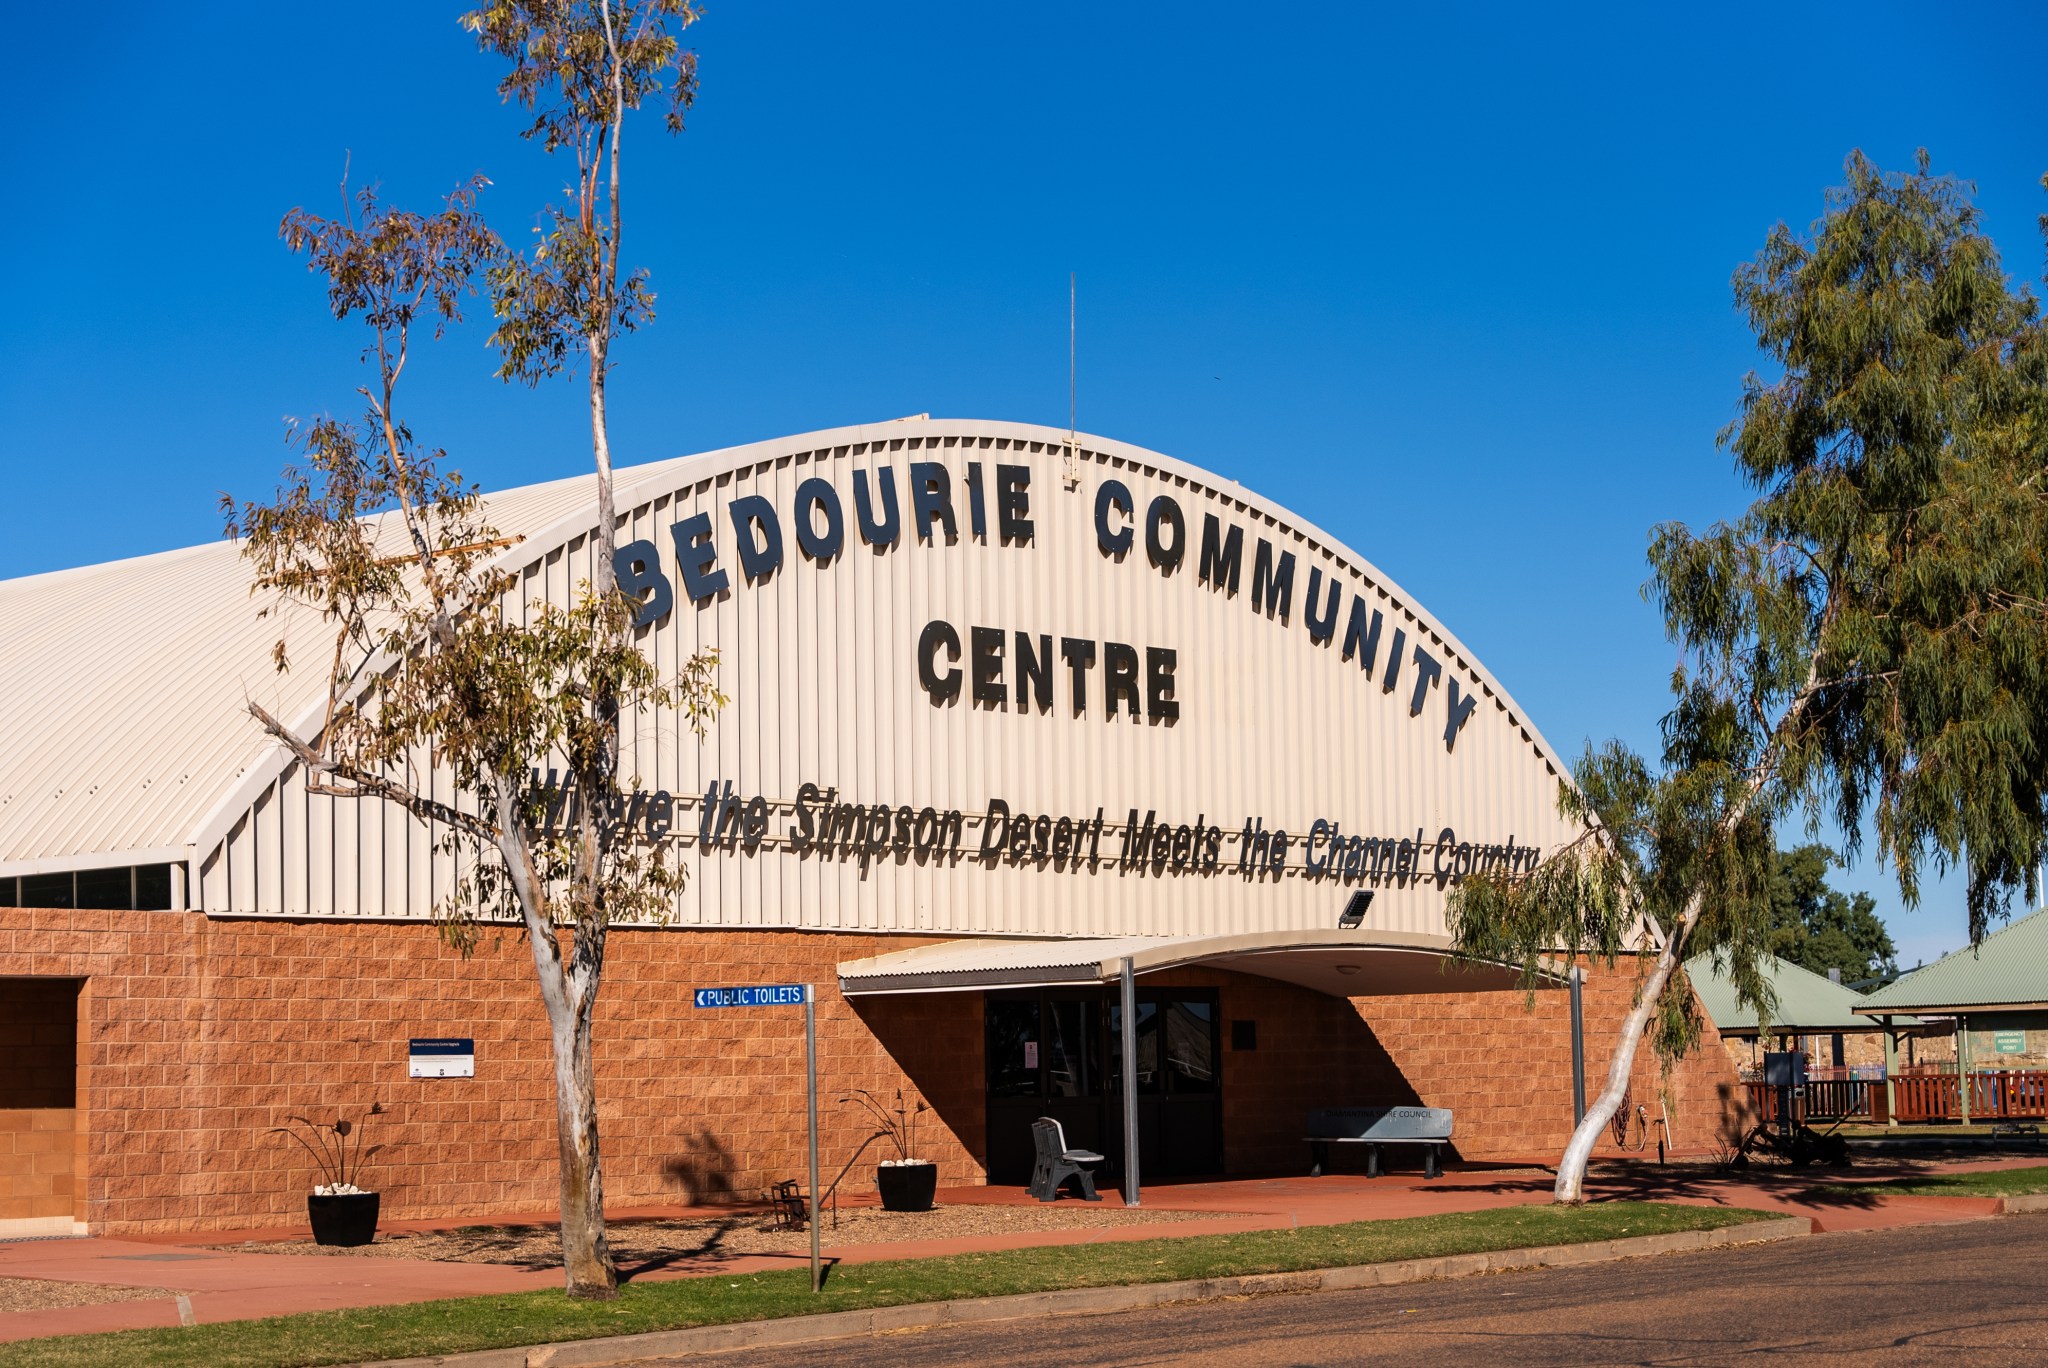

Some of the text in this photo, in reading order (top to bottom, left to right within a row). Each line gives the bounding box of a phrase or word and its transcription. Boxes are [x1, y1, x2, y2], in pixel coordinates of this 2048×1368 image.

[613, 461, 1478, 749] BEDOURIE COMMUNITY
[917, 619, 1180, 722] CENTRE
[699, 779, 769, 848] the
[789, 782, 963, 872] Simpson
[978, 797, 1104, 863] Desert
[1119, 808, 1221, 870] Meets
[1239, 816, 1288, 873] the
[1305, 818, 1424, 877] Channel
[707, 986, 801, 1006] PUBLIC TOILETS
[1375, 1110, 1397, 1118] SHIRE
[1398, 1110, 1433, 1118] COUNCIL
